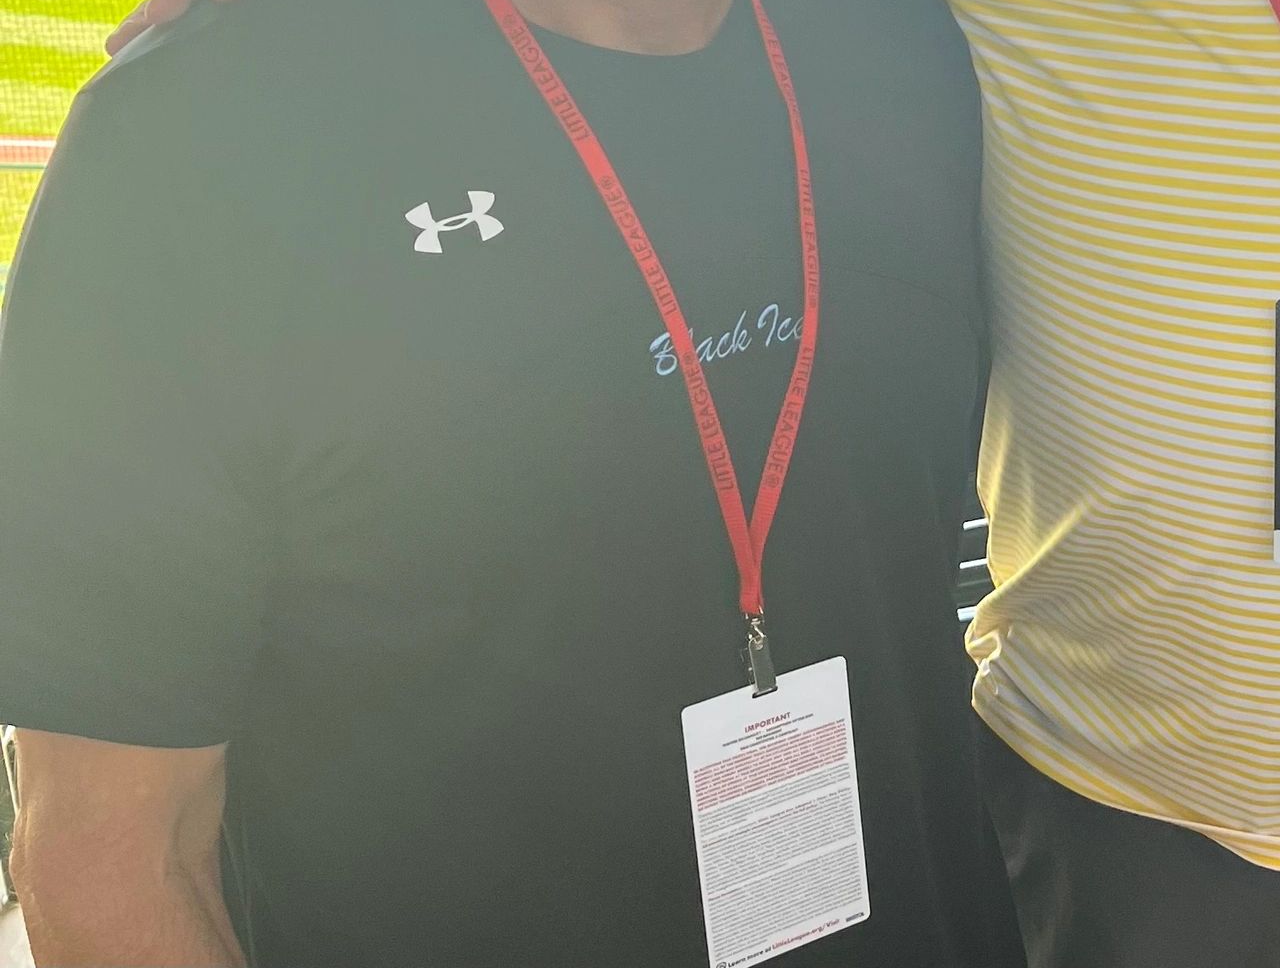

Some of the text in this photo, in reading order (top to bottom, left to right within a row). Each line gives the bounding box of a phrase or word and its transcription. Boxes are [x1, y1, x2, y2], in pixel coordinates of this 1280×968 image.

[552, 94, 591, 142] LITTLE
[647, 264, 677, 316] LITTLE
[650, 310, 752, 375] Back
[708, 443, 736, 491] LITTLE
[744, 712, 791, 732] IMPORTANT
[728, 956, 746, 968] Learn
[747, 950, 764, 960] more
